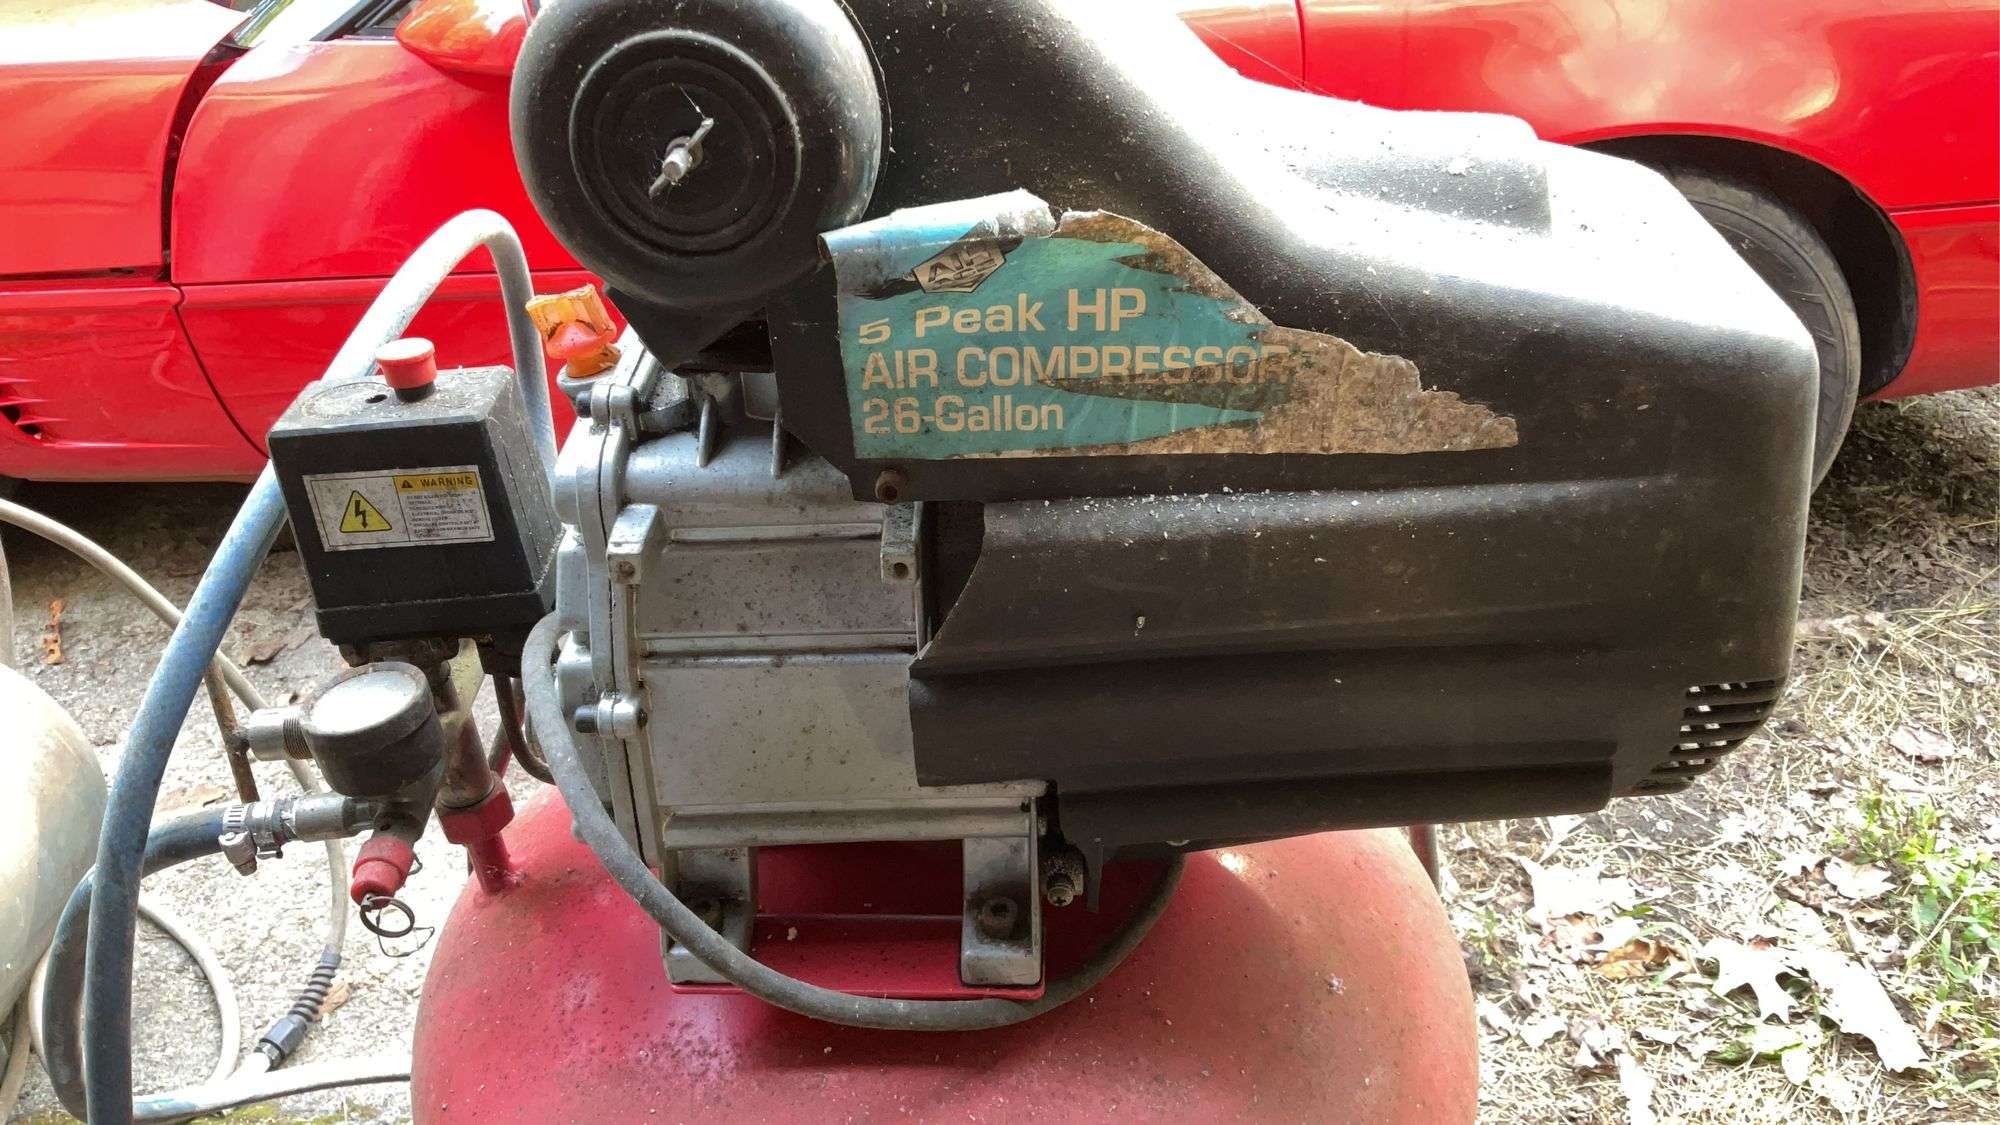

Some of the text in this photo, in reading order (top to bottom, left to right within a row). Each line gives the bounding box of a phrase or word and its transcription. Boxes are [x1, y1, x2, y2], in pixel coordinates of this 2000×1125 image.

[859, 288, 1147, 344] 5 Peak HP
[862, 346, 1292, 390] AIR COMPRESSOR
[863, 394, 1064, 434] 26-Gallon
[420, 476, 473, 488] WARNING
